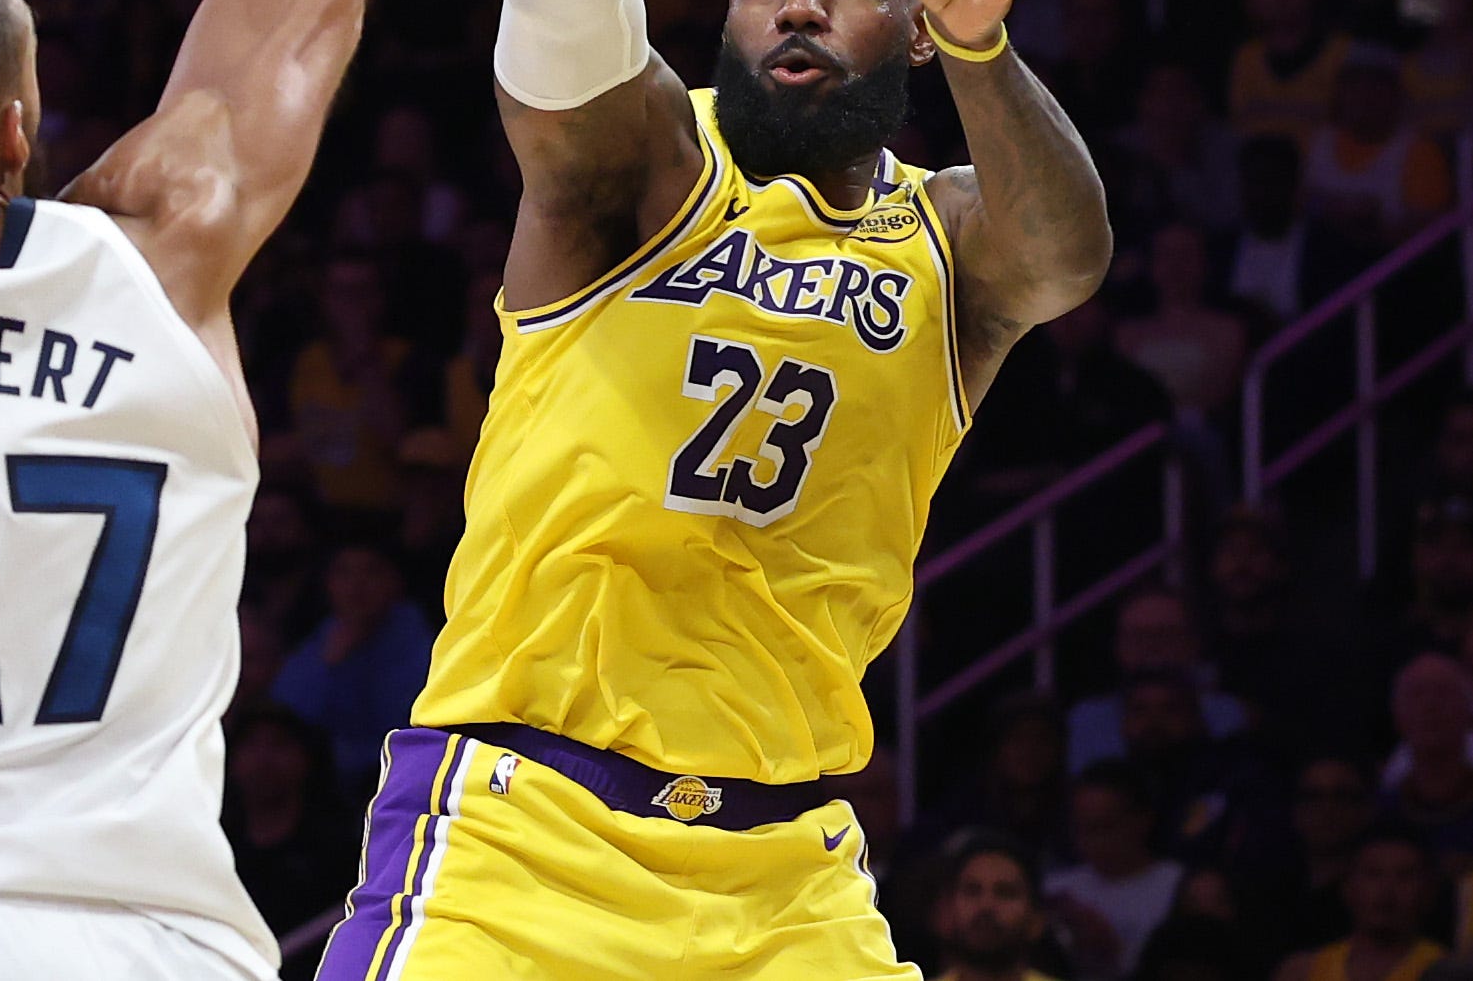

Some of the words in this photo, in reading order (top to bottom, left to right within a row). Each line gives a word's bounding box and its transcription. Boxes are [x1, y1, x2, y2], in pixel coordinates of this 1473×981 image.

[625, 226, 915, 354] LAKERS
[663, 334, 839, 528] 23
[652, 784, 722, 814] LAKERS
